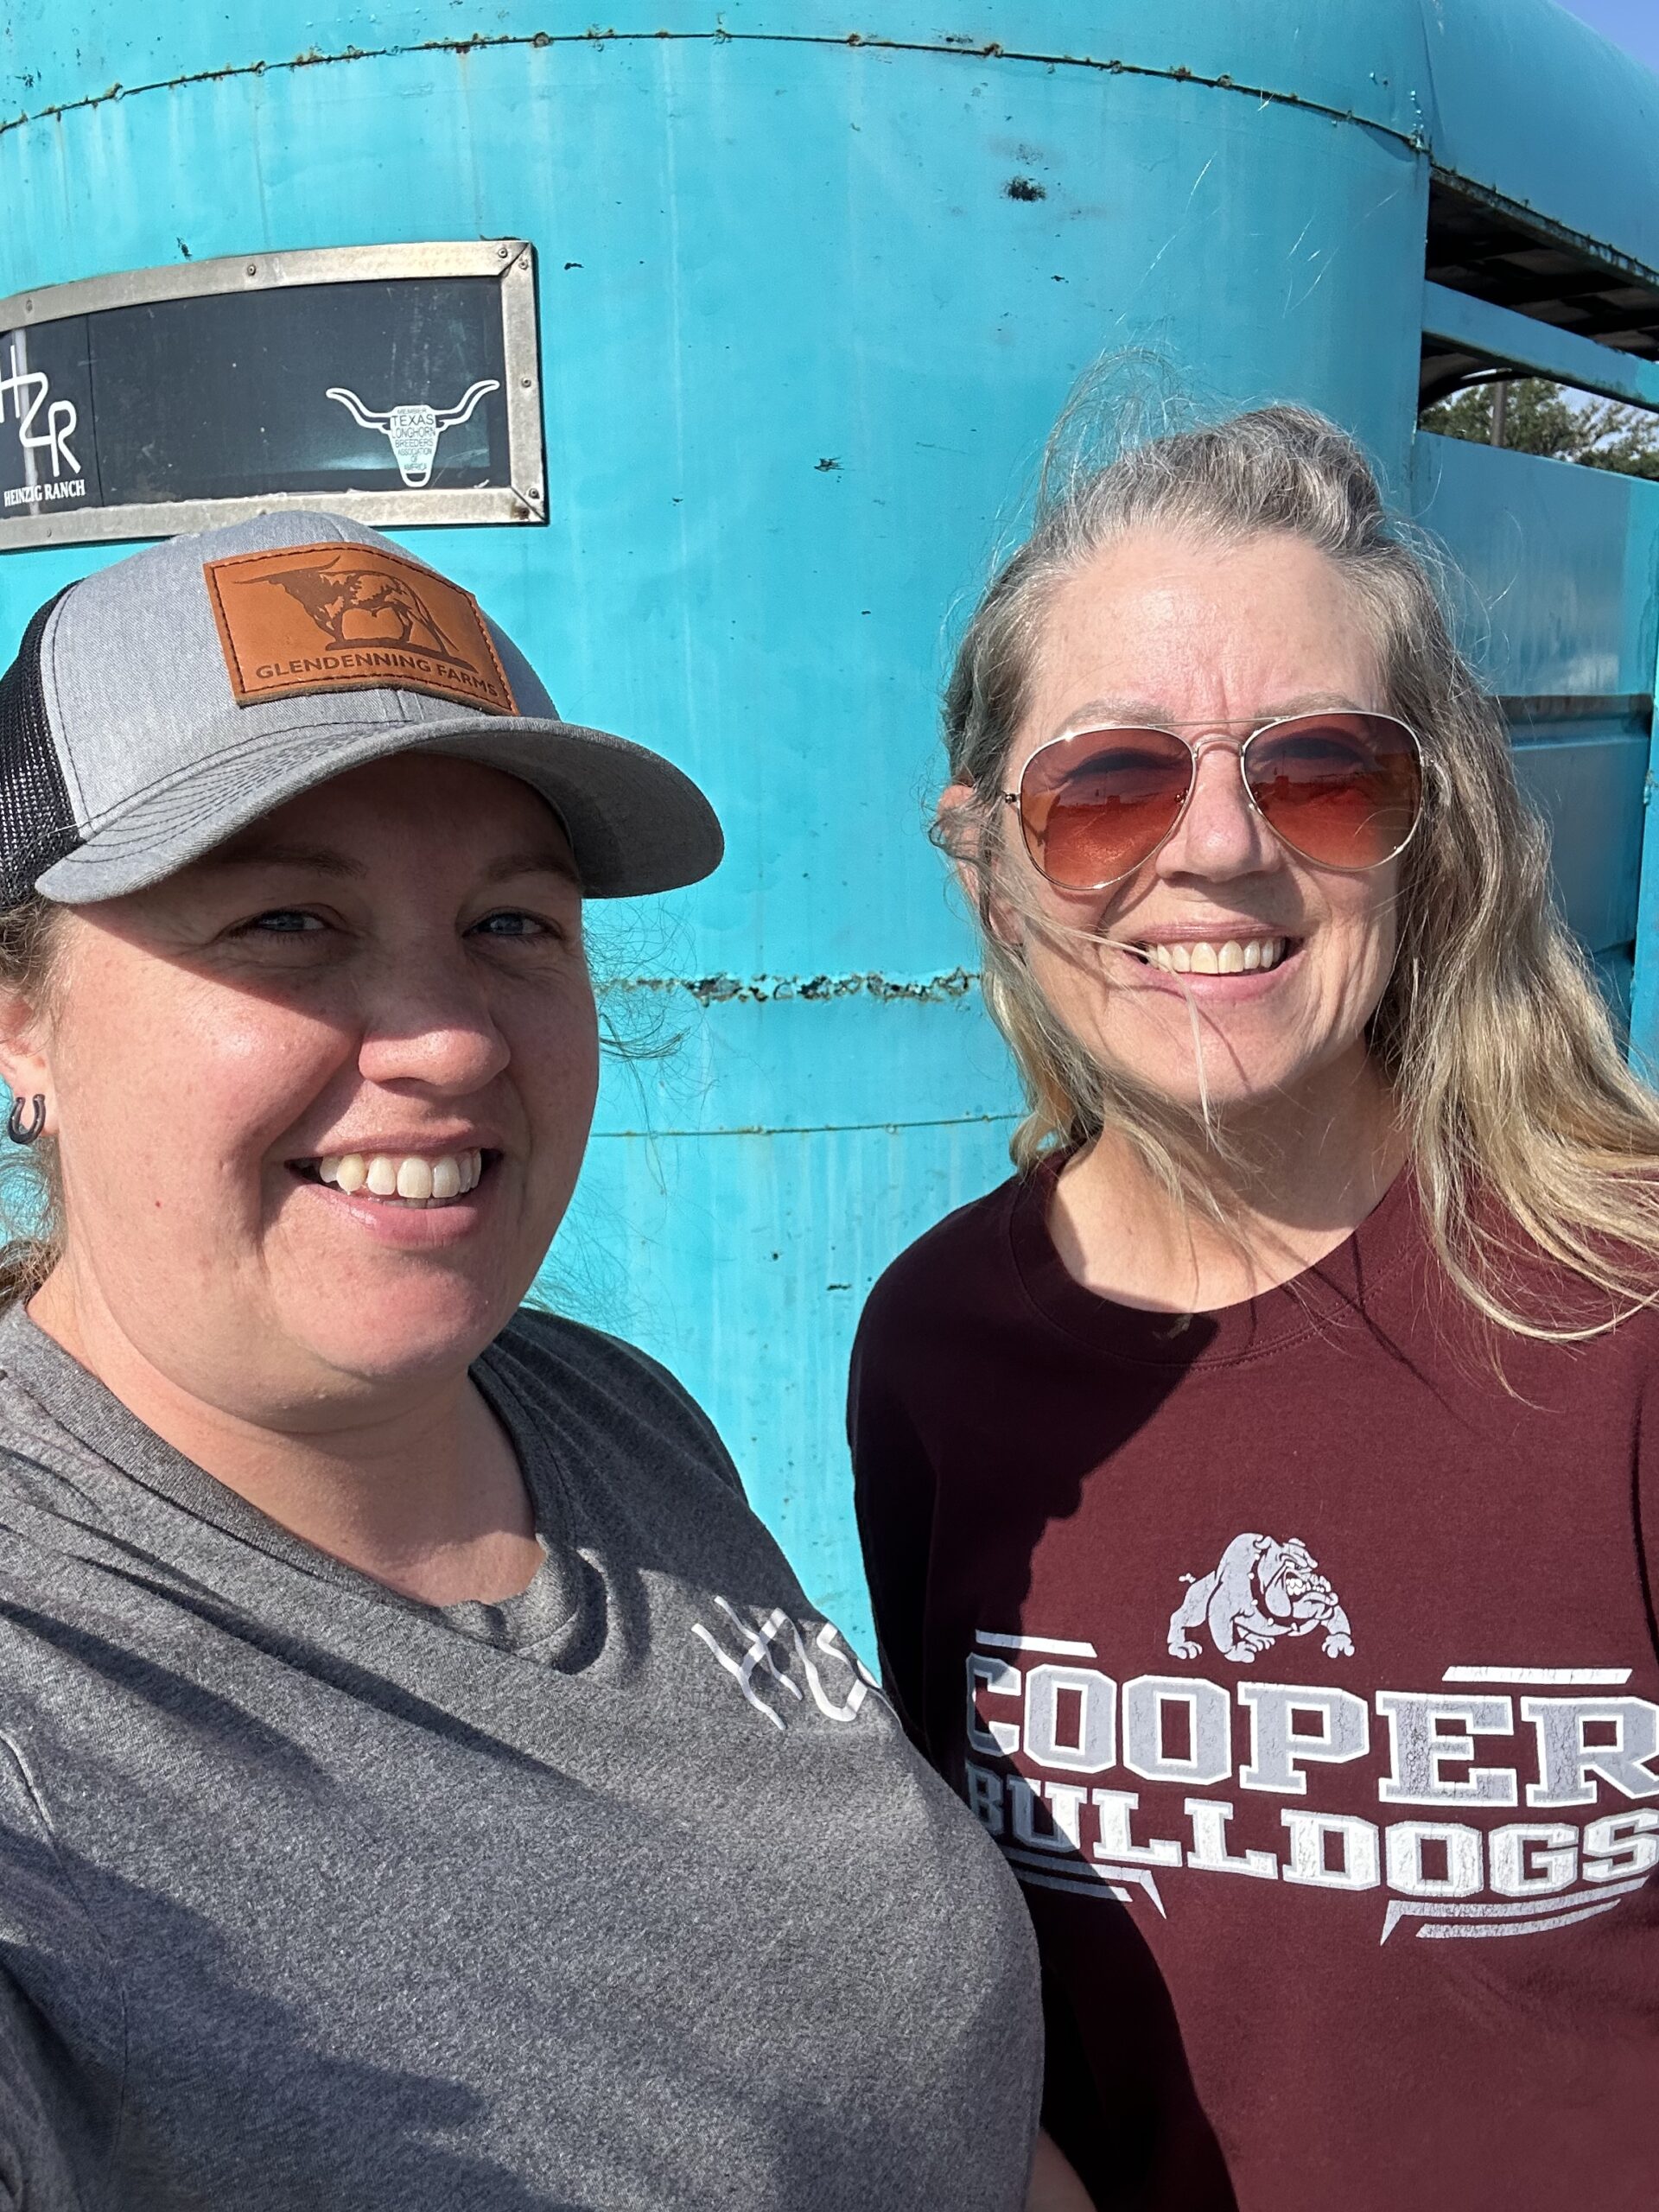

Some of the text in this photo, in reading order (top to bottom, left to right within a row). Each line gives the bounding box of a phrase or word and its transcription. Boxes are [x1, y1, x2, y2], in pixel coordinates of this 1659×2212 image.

[391, 414, 435, 427] TEXAS
[391, 426, 436, 439] LONGHORN
[395, 438, 434, 448] BREEDERS
[397, 448, 432, 456] ASSOCIATION
[3, 479, 86, 506] HEINZIG RANCH
[255, 652, 499, 697] GLENDENNING FARMS
[965, 1651, 1659, 1808] COOPER
[964, 1758, 1659, 1897] BULLDOGS
